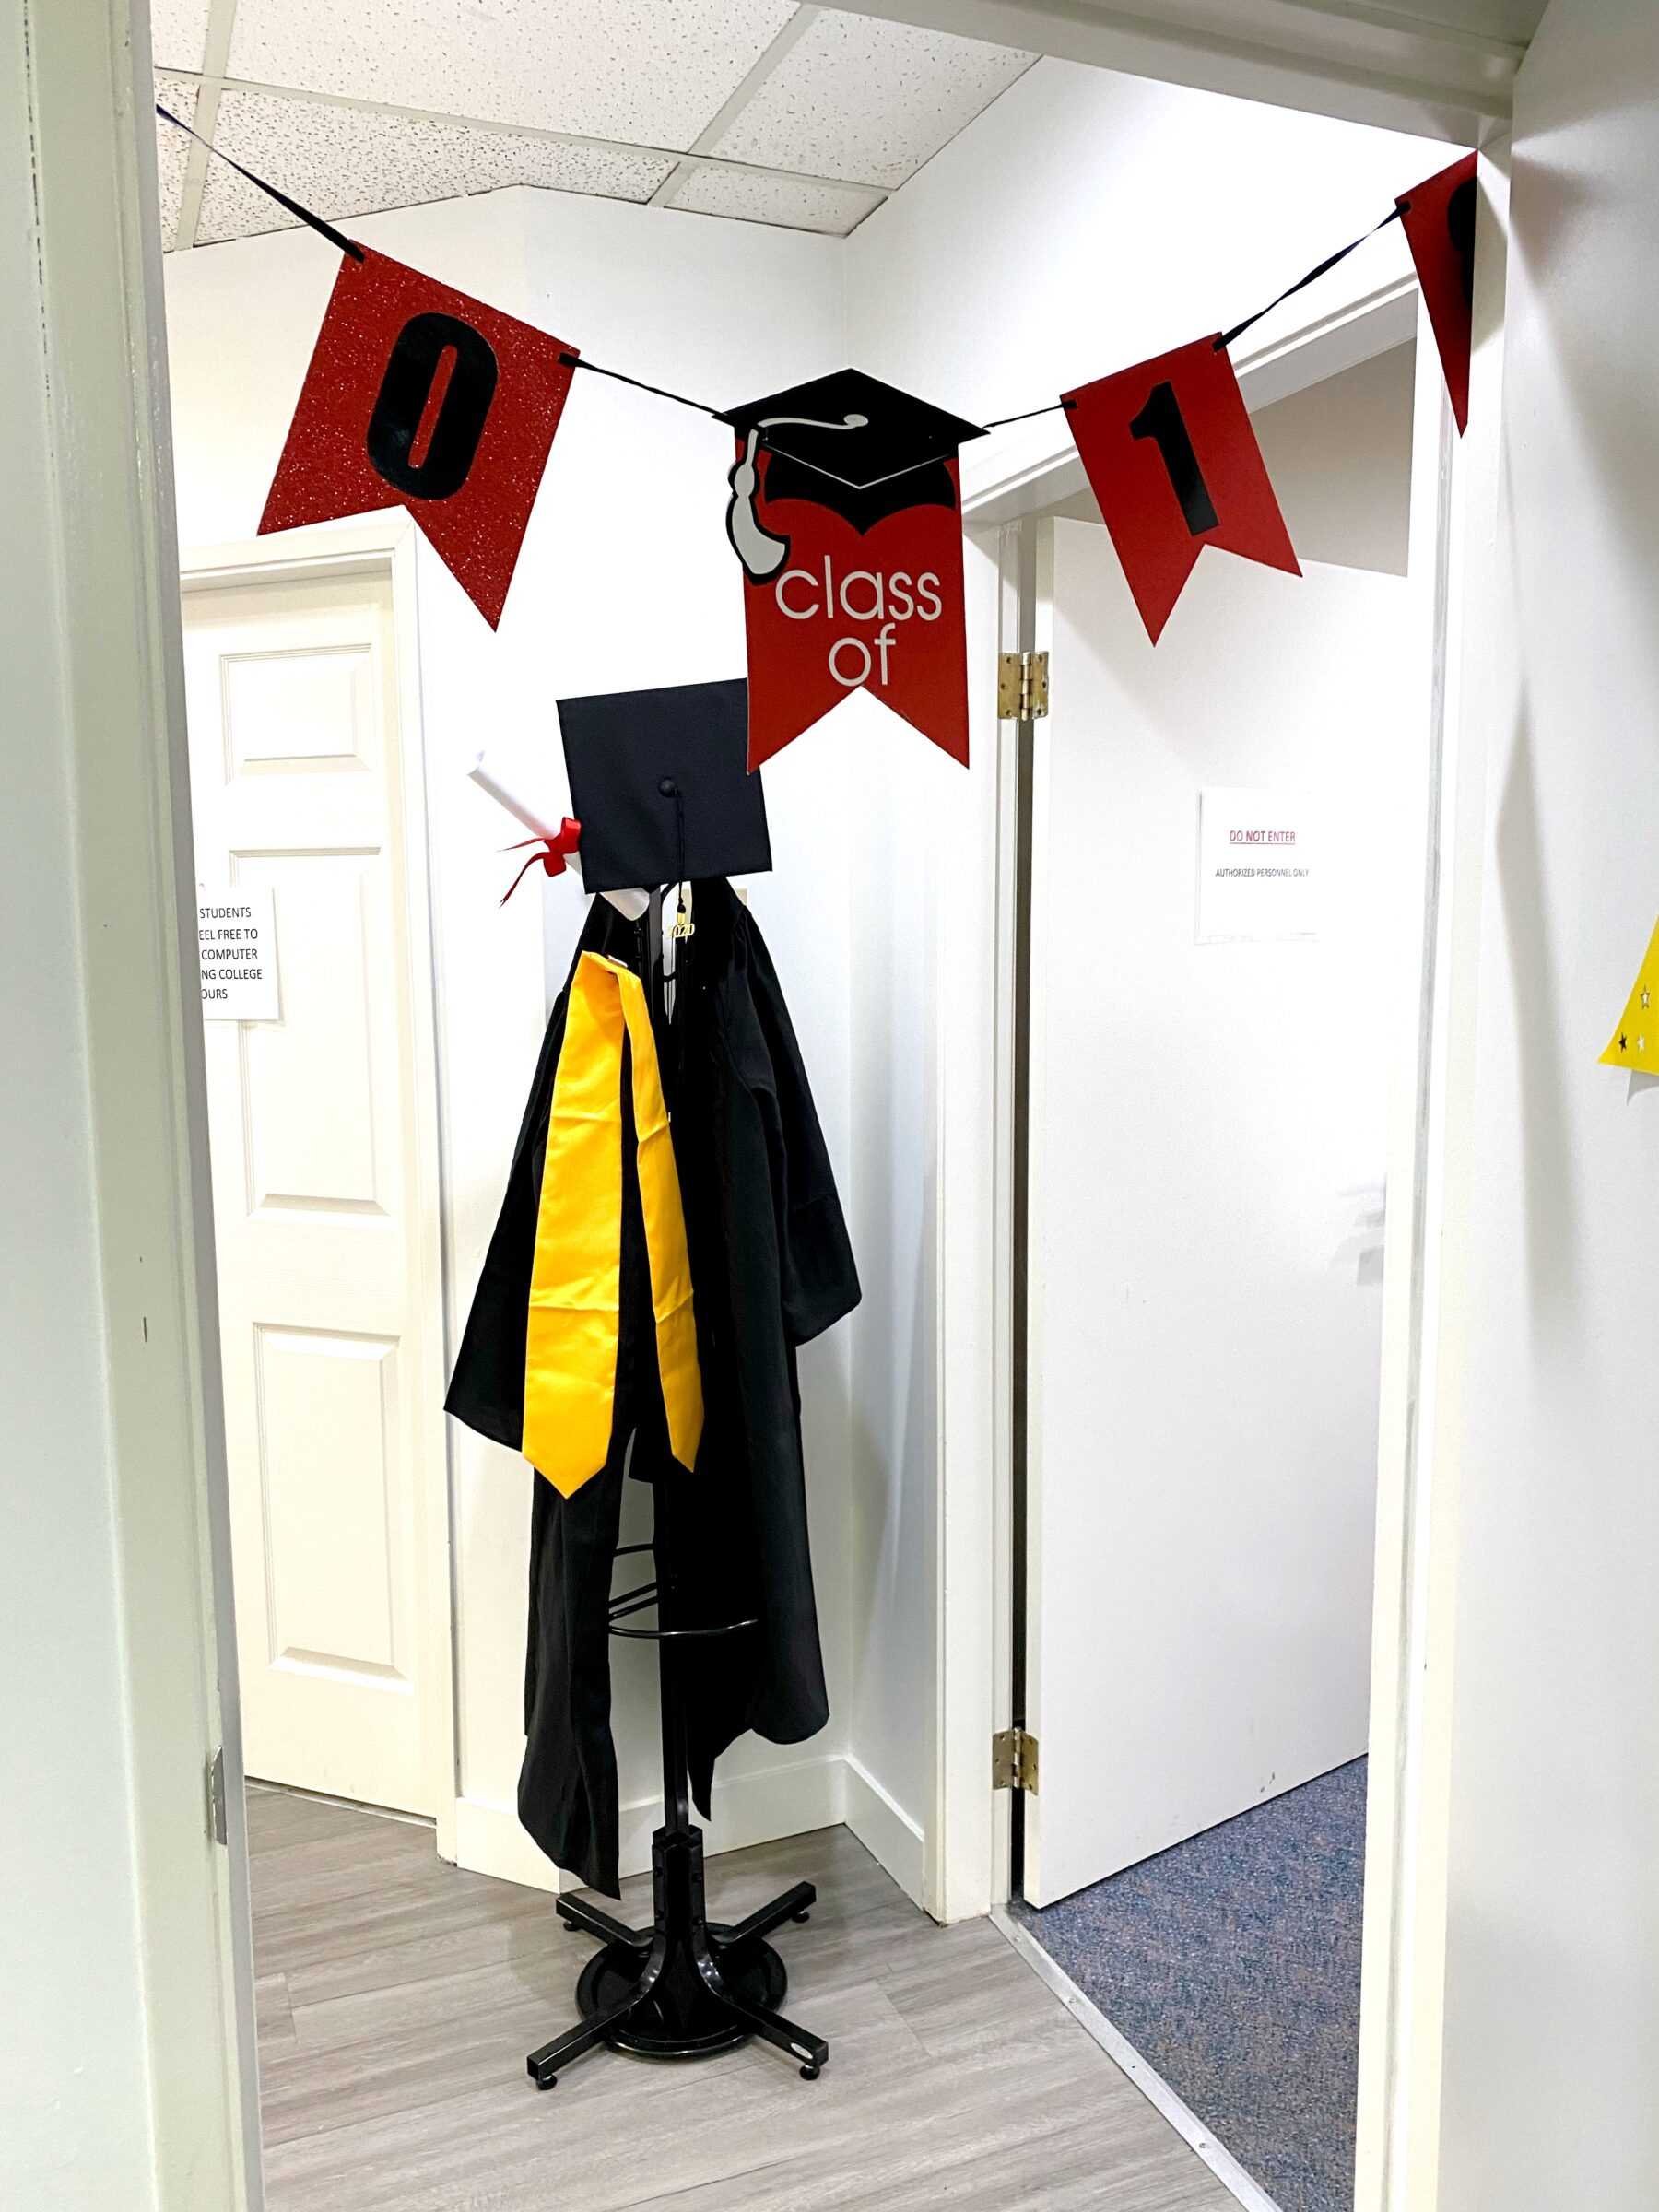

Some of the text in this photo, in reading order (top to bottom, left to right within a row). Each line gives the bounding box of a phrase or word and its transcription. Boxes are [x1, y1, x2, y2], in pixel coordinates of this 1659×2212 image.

[1128, 380, 1220, 537] 1
[775, 554, 942, 621] class
[829, 622, 896, 687] of
[1230, 830, 1296, 842] DO NOT ENTER
[1215, 868, 1310, 877] AUTHORIZED PERSONNEL ONLY
[199, 907, 252, 919] STUDENTS
[218, 929, 241, 940] FREE
[243, 928, 258, 940] TO
[201, 948, 258, 960] COMPUTER
[218, 968, 263, 980] COLLEGE
